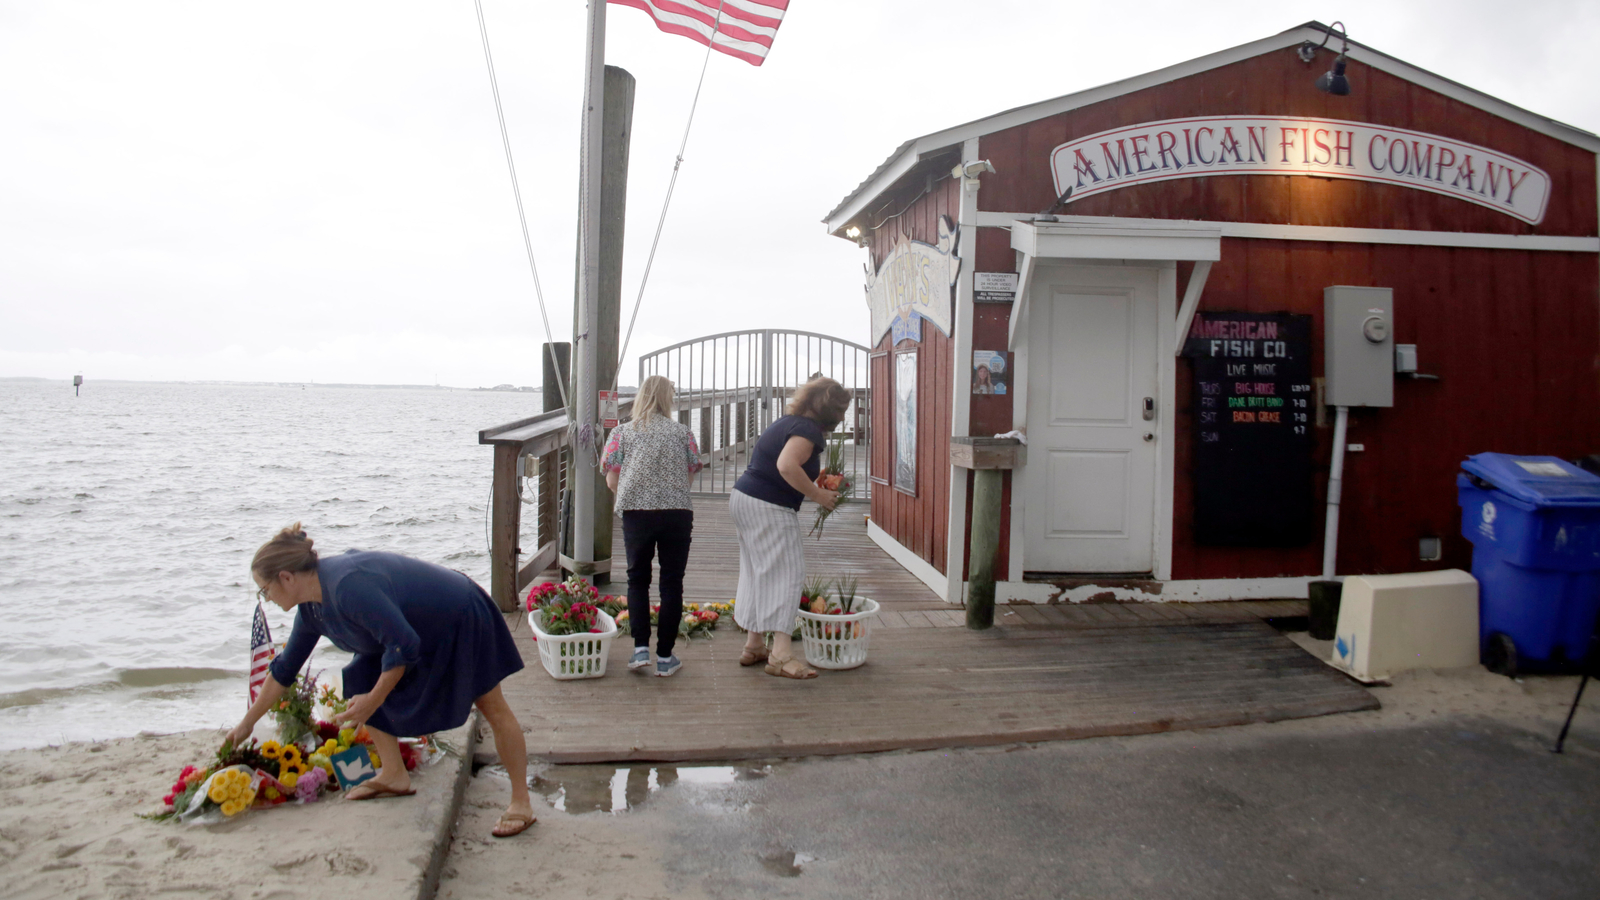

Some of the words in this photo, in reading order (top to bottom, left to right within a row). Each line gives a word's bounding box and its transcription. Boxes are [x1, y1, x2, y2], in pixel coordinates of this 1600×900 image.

[1072, 126, 1268, 190] AMERICAN
[1278, 127, 1355, 169] FISH
[1367, 134, 1530, 207] COMPANY
[1190, 313, 1278, 339] AMERICAN
[1210, 340, 1255, 357] FISH
[1227, 363, 1247, 376] LIVE
[1253, 363, 1277, 375] MUSIC
[1235, 382, 1252, 395] BIG
[1254, 382, 1276, 395] HOUSE
[1228, 397, 1246, 408] DANE
[1266, 397, 1284, 408] BAND
[1201, 411, 1217, 423] SAT
[1233, 411, 1256, 423] BACON
[1258, 411, 1281, 423] GREASE
[1201, 431, 1219, 442] SUN
